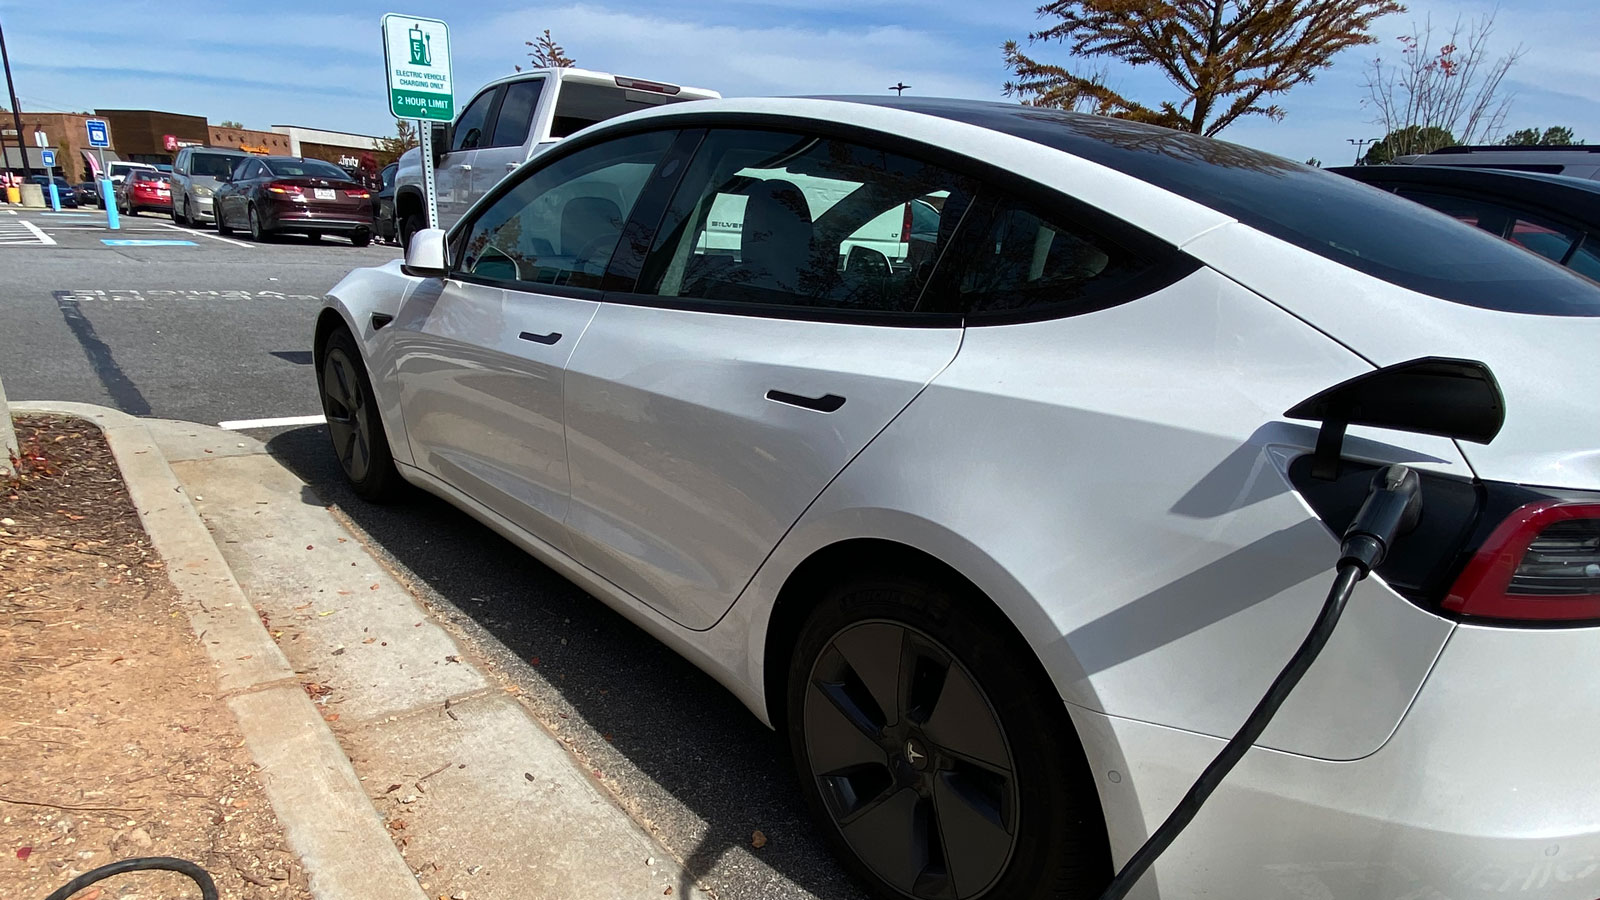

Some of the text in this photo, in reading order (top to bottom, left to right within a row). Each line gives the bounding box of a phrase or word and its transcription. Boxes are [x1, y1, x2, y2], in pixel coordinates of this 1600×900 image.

[396, 70, 446, 81] ELECTRIC VEHICLE
[400, 79, 428, 87] CHARGING
[397, 96, 448, 108] 2 HOUR LIMIT
